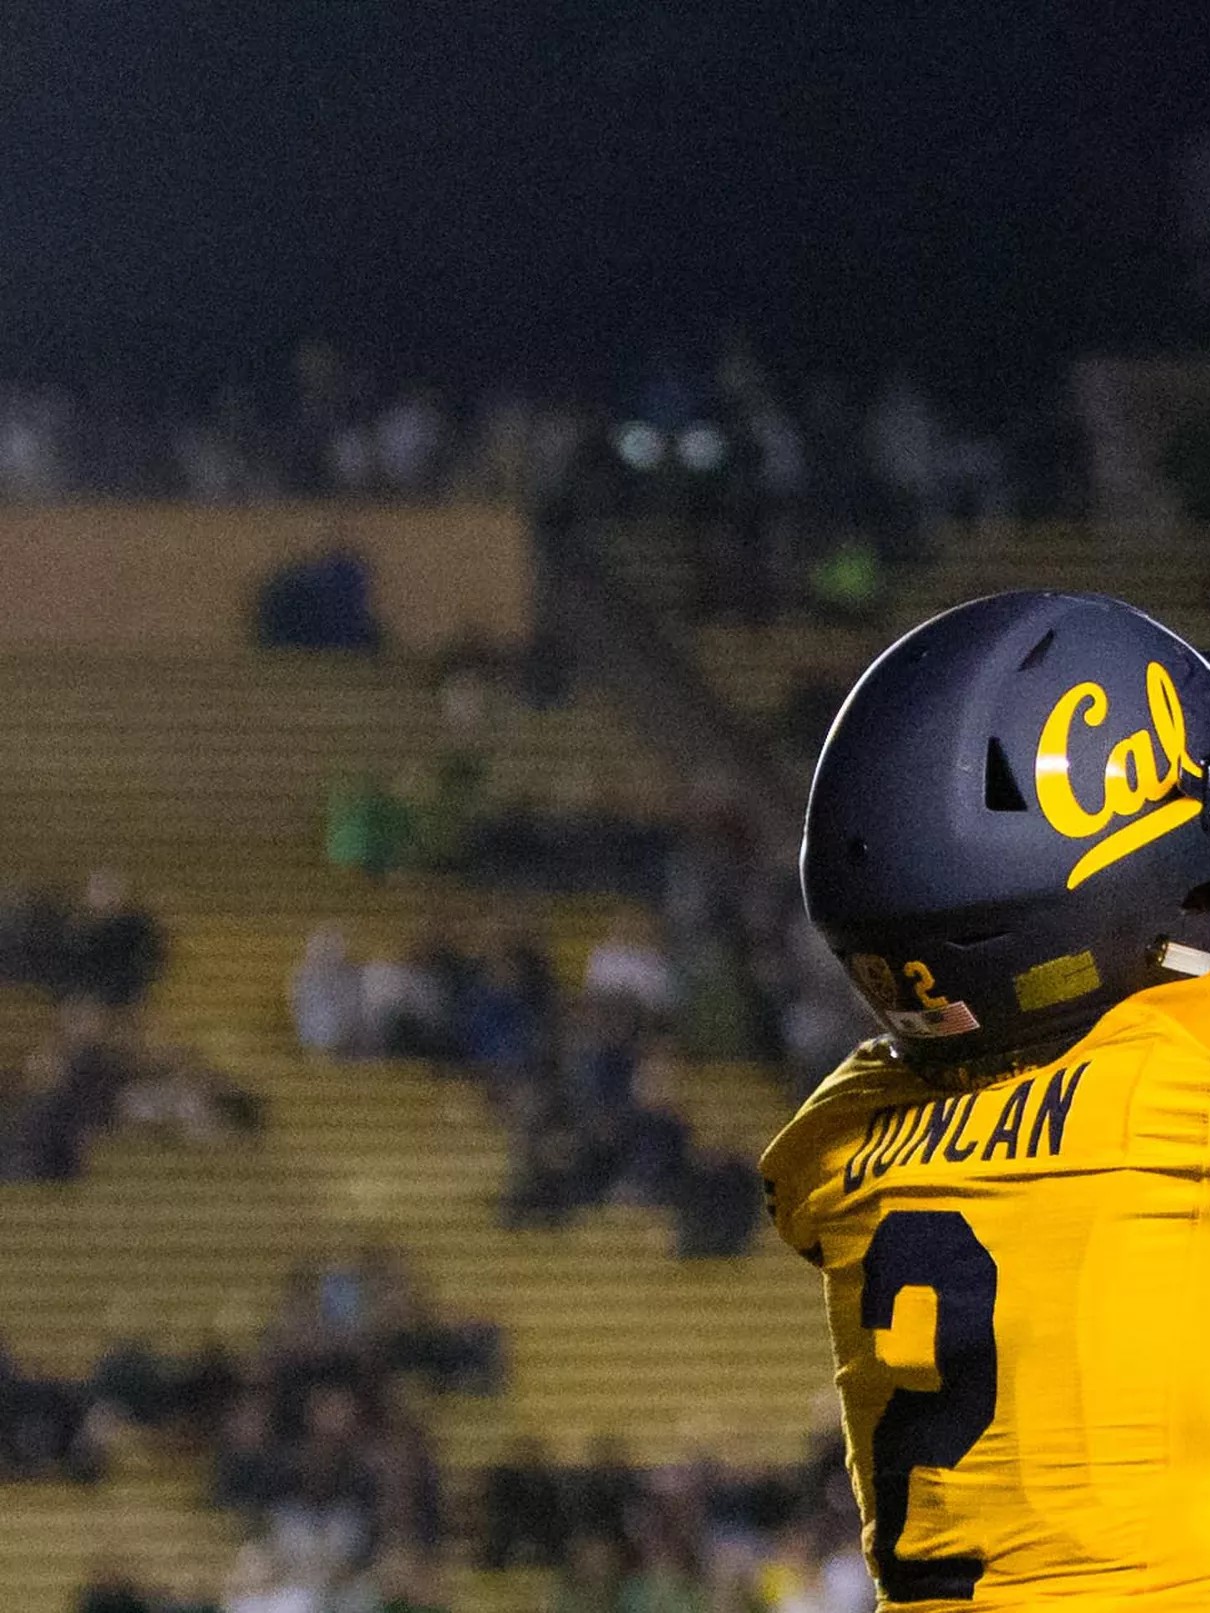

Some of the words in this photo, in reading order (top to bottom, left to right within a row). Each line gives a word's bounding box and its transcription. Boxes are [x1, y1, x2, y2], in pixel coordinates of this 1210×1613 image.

[1035, 661, 1203, 890] Cal
[904, 961, 948, 1009] 2
[843, 1060, 1092, 1194] DUNCAN
[860, 1210, 998, 1600] 2
